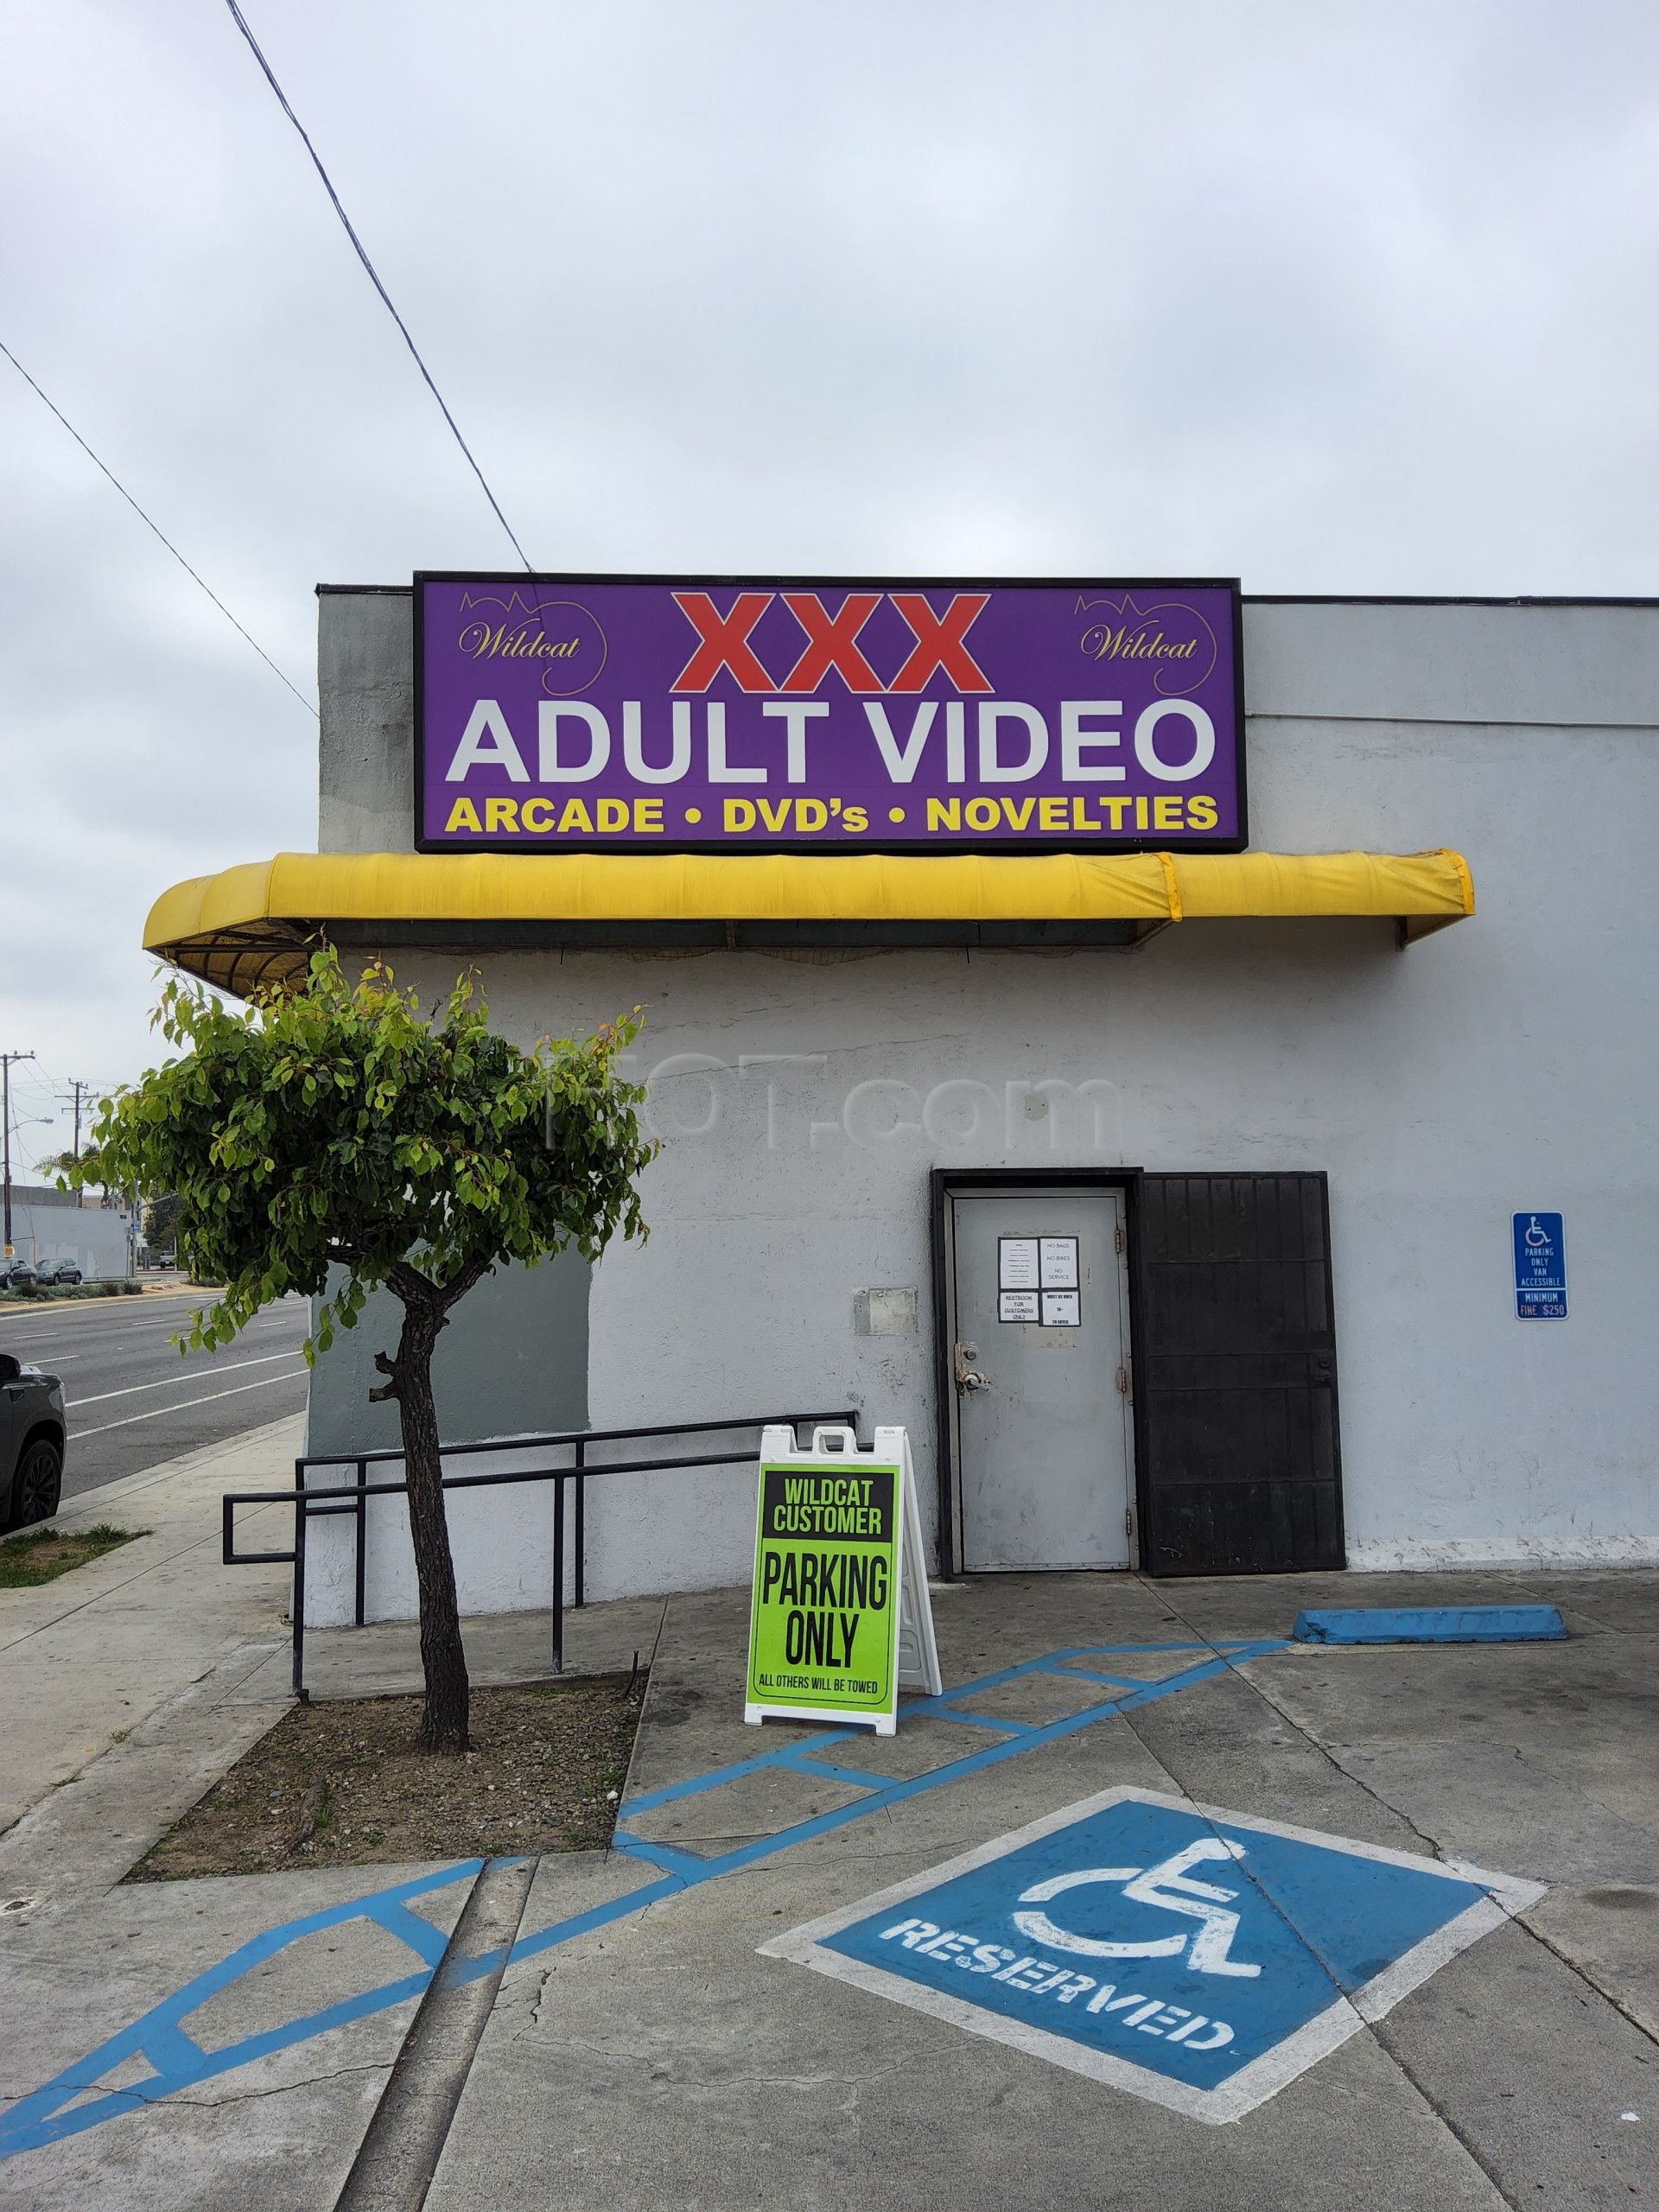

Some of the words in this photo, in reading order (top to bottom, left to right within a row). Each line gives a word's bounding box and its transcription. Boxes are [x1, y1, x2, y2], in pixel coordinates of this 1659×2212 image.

[459, 618, 580, 659] Wildcat
[670, 592, 995, 694] XXX
[1080, 620, 1198, 661] Wildcat
[445, 700, 830, 784] ADULT
[863, 698, 1216, 784] VIDEO
[445, 798, 664, 833] ARCADE
[723, 798, 869, 833] DVD's
[926, 796, 1219, 832] NOVELTIES
[1525, 1247, 1554, 1256] PARKING
[1531, 1257, 1548, 1267] ONLY
[1521, 1277, 1560, 1287] ACCESSIBLE
[1534, 1268, 1547, 1276] VAN
[1521, 1305, 1537, 1316] FINE
[1542, 1305, 1565, 1316] $250
[1525, 1292, 1558, 1303] MINIMUM
[785, 1478, 874, 1507] WILDCAT
[773, 1504, 881, 1535] CUSTOMER
[762, 1551, 887, 1611] PARKING
[785, 1610, 860, 1669] ONLY
[759, 1674, 774, 1687] ALL
[776, 1675, 810, 1689] OTHERS
[811, 1676, 832, 1691] WILL
[834, 1678, 845, 1692] BE
[847, 1679, 878, 1694] TOWED
[879, 1917, 1236, 2050] RESERVED
